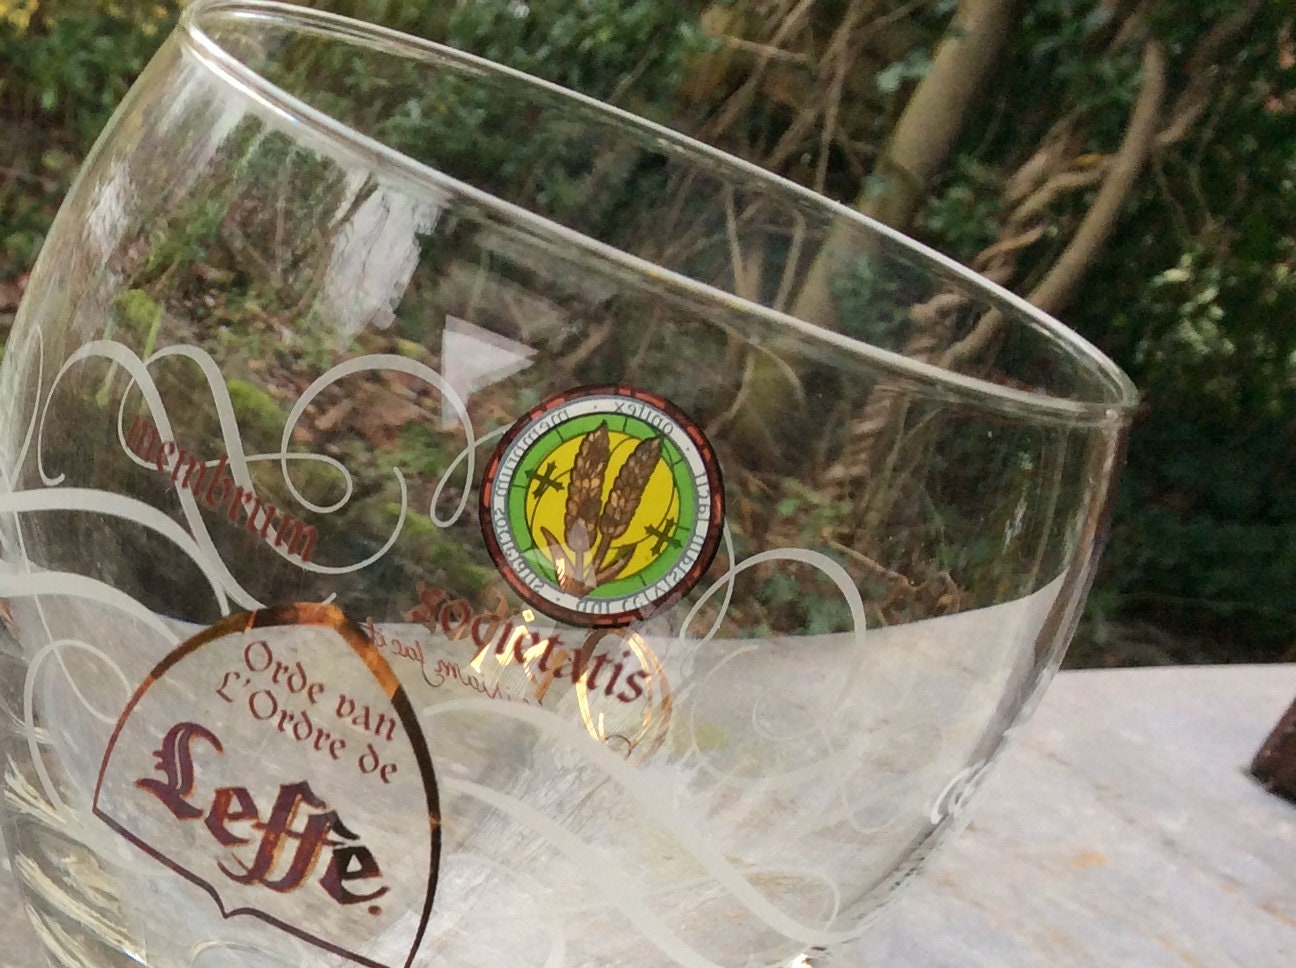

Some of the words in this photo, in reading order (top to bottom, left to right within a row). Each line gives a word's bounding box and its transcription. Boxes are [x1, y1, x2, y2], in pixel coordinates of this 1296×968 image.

[215, 670, 347, 760] L'Ordre
[357, 743, 399, 784] de
[243, 640, 325, 704] Orde
[335, 694, 397, 741] van
